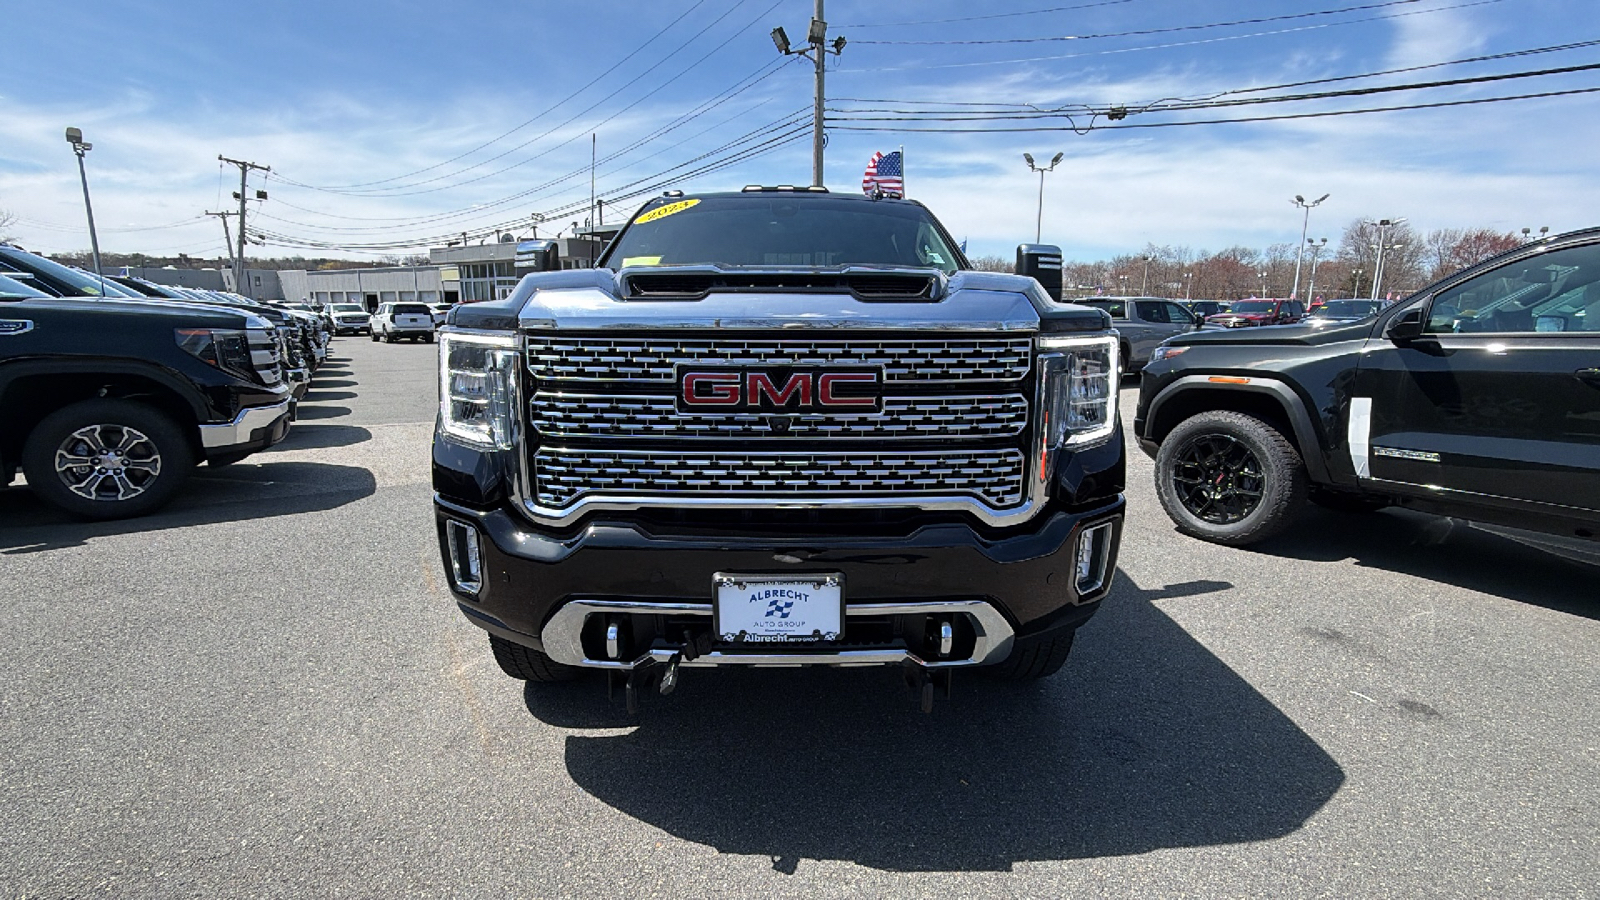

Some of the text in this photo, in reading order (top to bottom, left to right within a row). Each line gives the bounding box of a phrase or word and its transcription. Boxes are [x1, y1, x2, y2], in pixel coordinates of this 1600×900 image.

[682, 372, 877, 406] GMC
[749, 589, 810, 603] ALBRECHT
[743, 633, 788, 642] Albrecht
